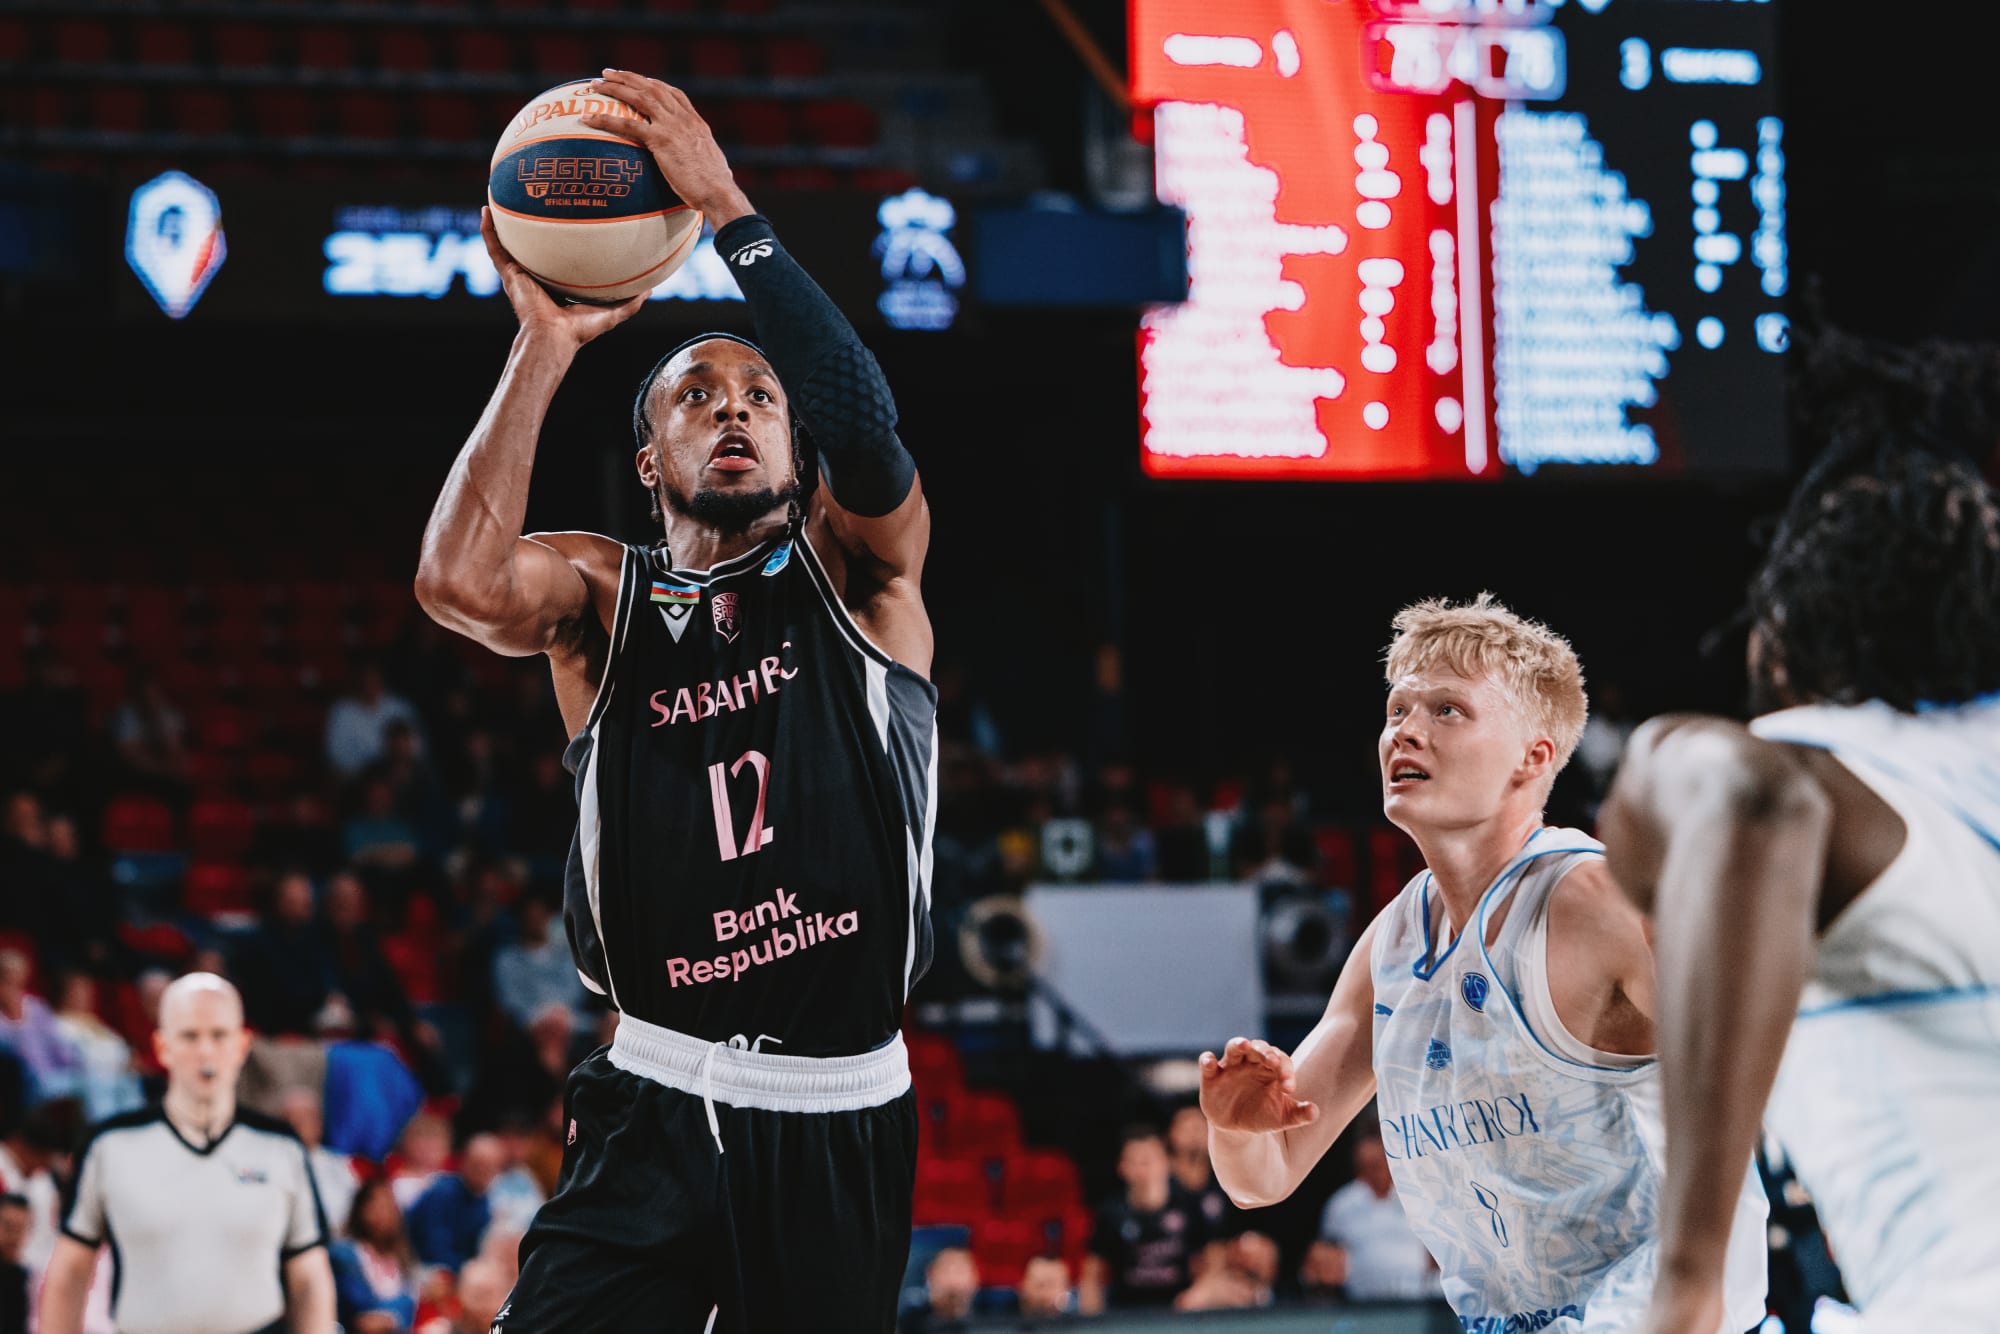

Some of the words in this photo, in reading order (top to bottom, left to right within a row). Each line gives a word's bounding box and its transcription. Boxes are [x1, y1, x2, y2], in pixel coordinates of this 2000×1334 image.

[514, 99, 645, 137] SPALDIN
[517, 157, 643, 182] LEGACY
[551, 182, 630, 196] 1000
[544, 198, 571, 206] OFFICIAL
[573, 198, 591, 206] GAME
[592, 199, 608, 207] BALL
[650, 669, 759, 727] SABAH
[708, 750, 775, 861] 12
[713, 888, 801, 942] Bank
[666, 911, 859, 987] Respublika
[1470, 1181, 1509, 1248] 8
